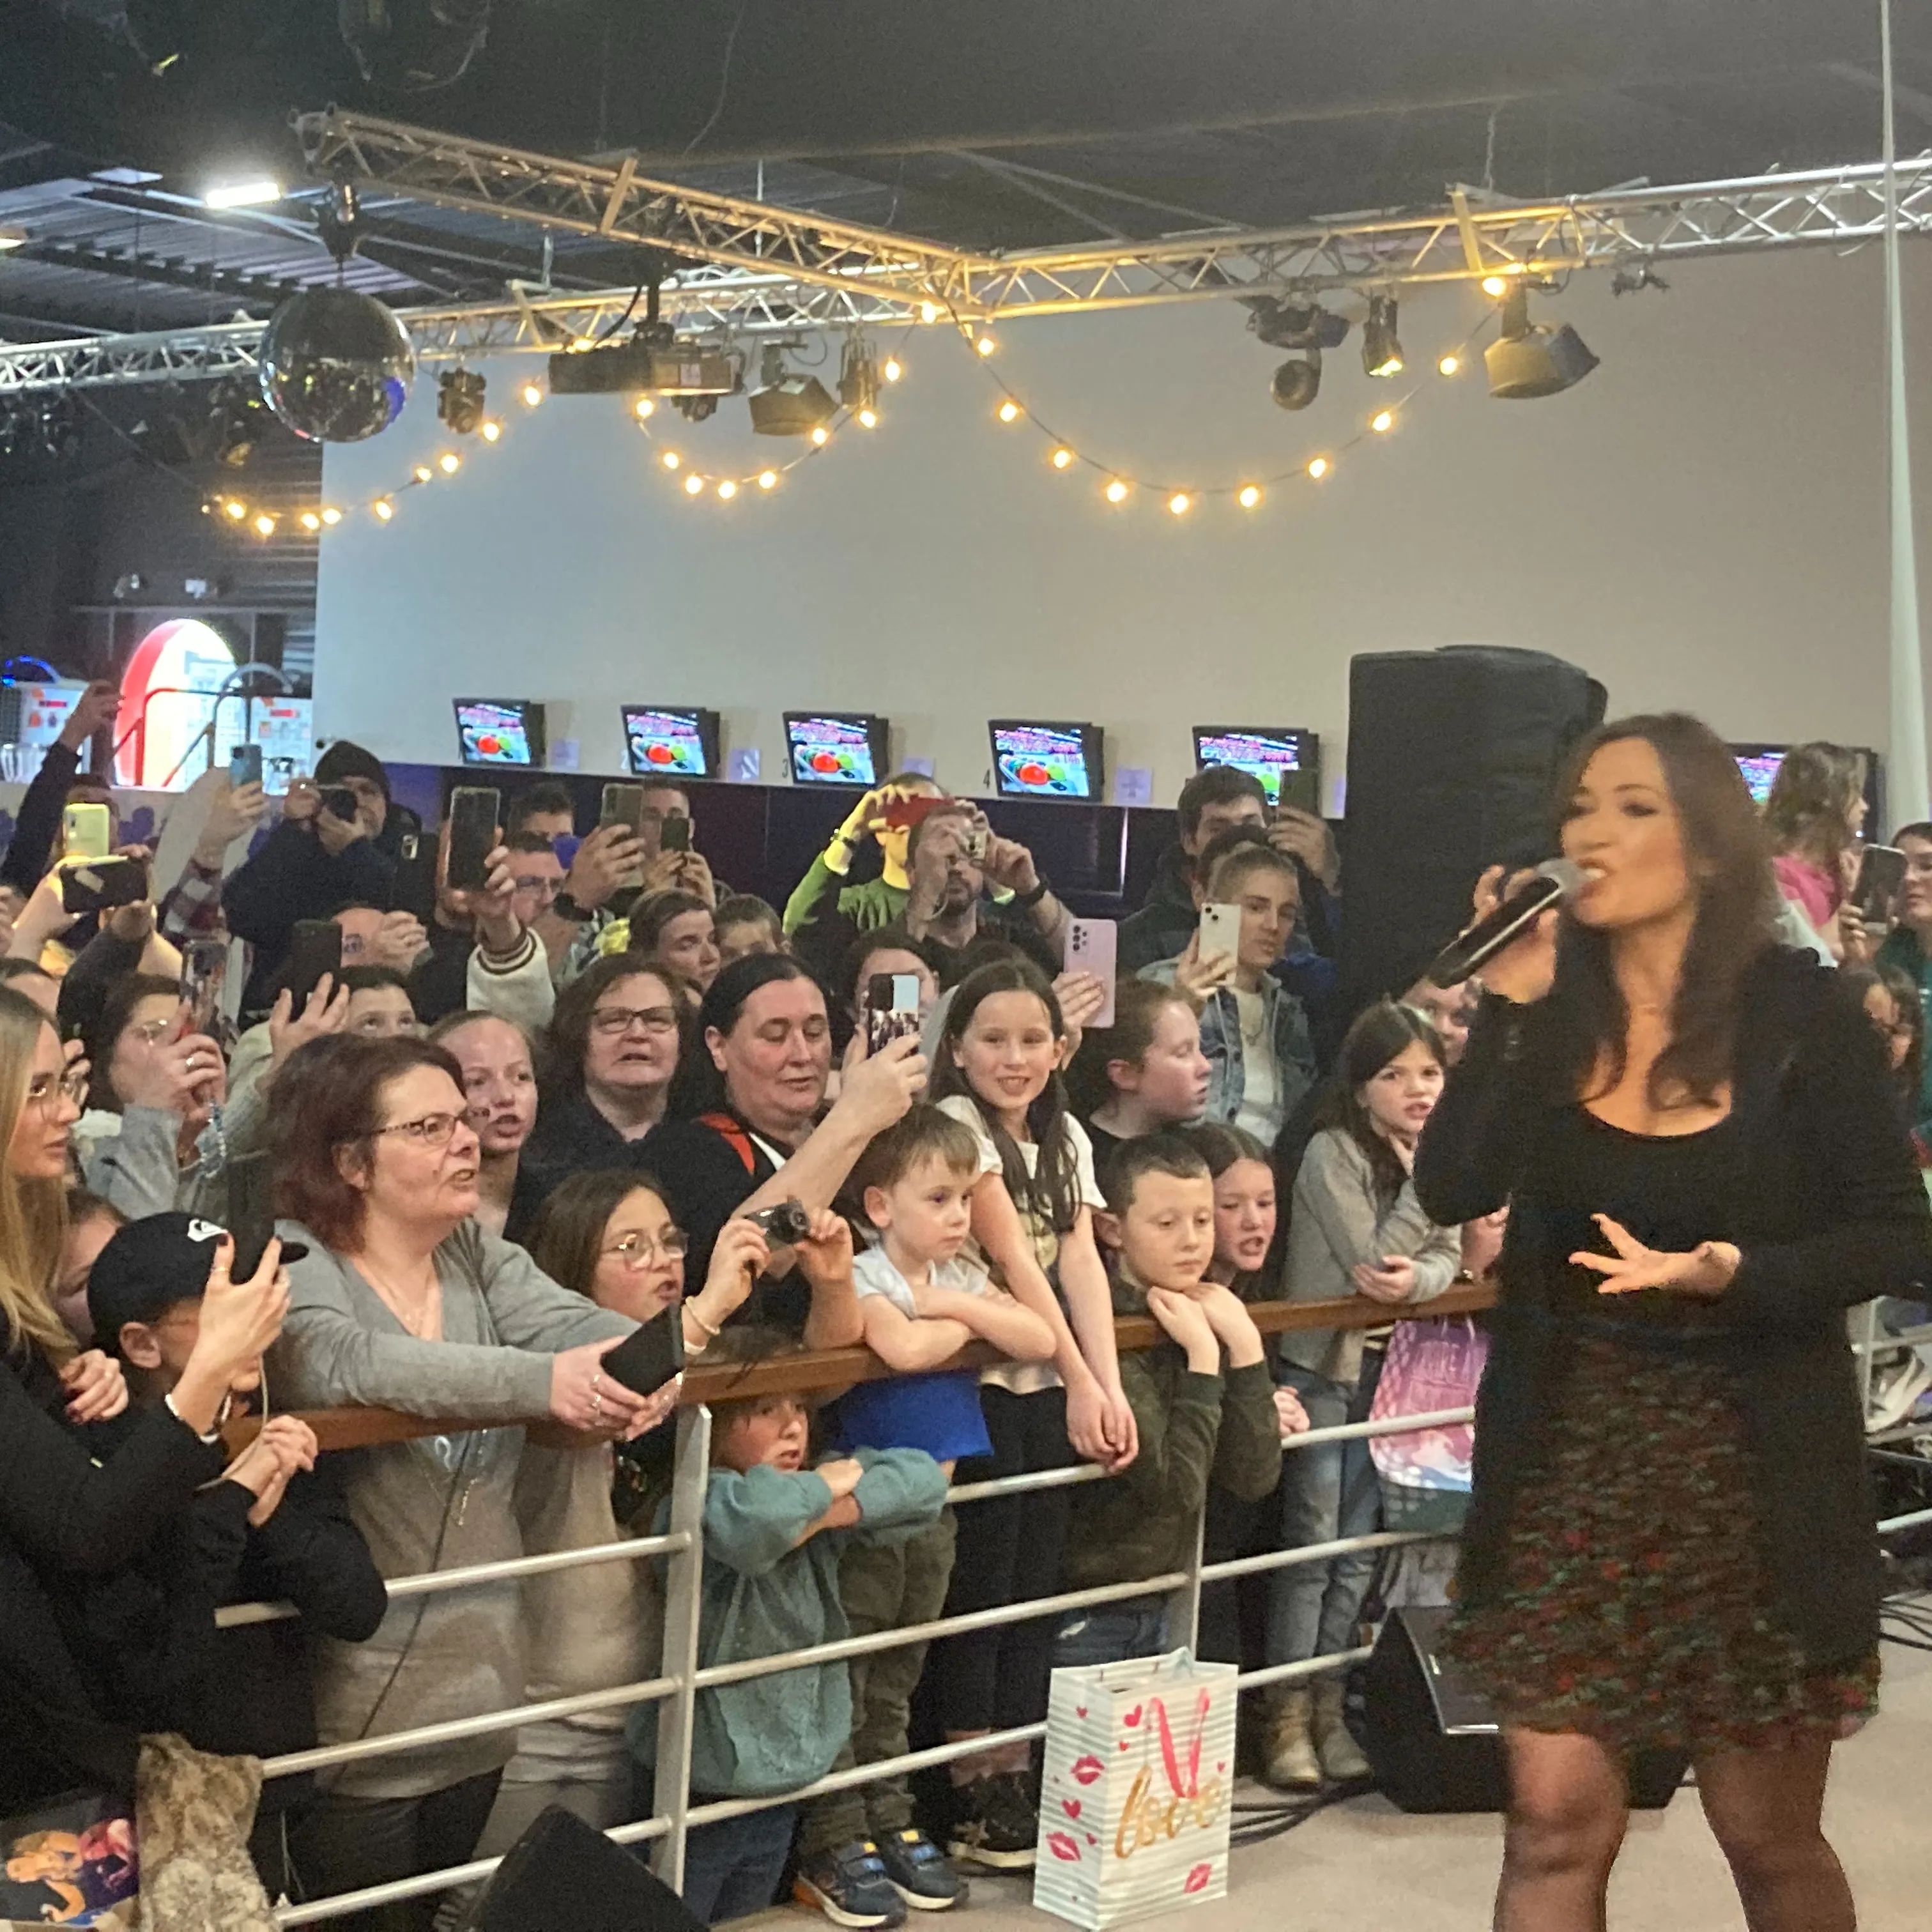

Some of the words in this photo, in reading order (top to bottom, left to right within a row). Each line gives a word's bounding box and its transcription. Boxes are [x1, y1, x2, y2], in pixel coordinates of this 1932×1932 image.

[620, 749, 629, 770] 2
[782, 758, 789, 778] 3
[983, 769, 990, 790] 4
